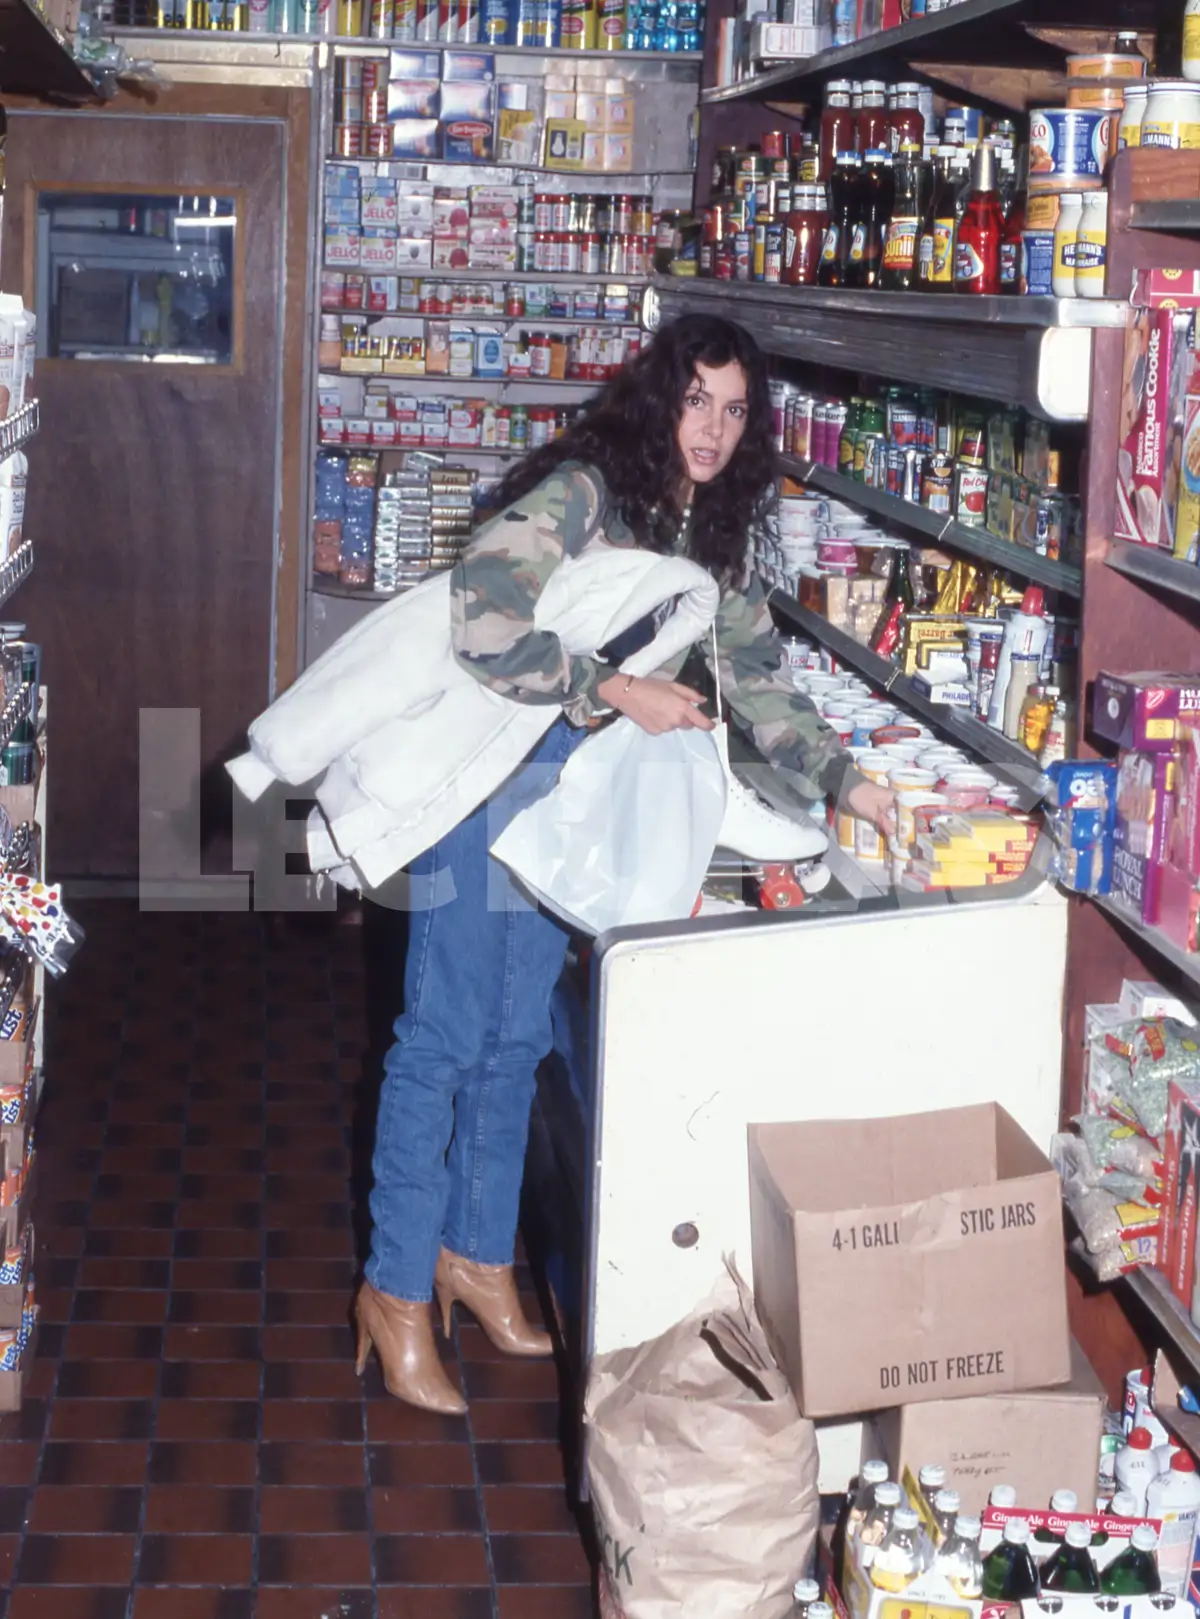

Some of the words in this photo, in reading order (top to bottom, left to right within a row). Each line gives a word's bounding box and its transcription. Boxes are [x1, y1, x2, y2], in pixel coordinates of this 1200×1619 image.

[1146, 328, 1161, 398] Cookie
[1141, 399, 1157, 476] Famous
[1114, 845, 1143, 880] ROYAL
[1112, 865, 1142, 901] LUNCH
[833, 1227, 857, 1251] 4-1
[960, 1208, 995, 1236] STIC
[1000, 1202, 1036, 1229] JARS
[880, 1366, 901, 1389] DO
[907, 1361, 938, 1386] NOT
[946, 1351, 1005, 1380] FREEZE
[1026, 1514, 1044, 1526] Ale
[1103, 1519, 1137, 1532] Ginger
